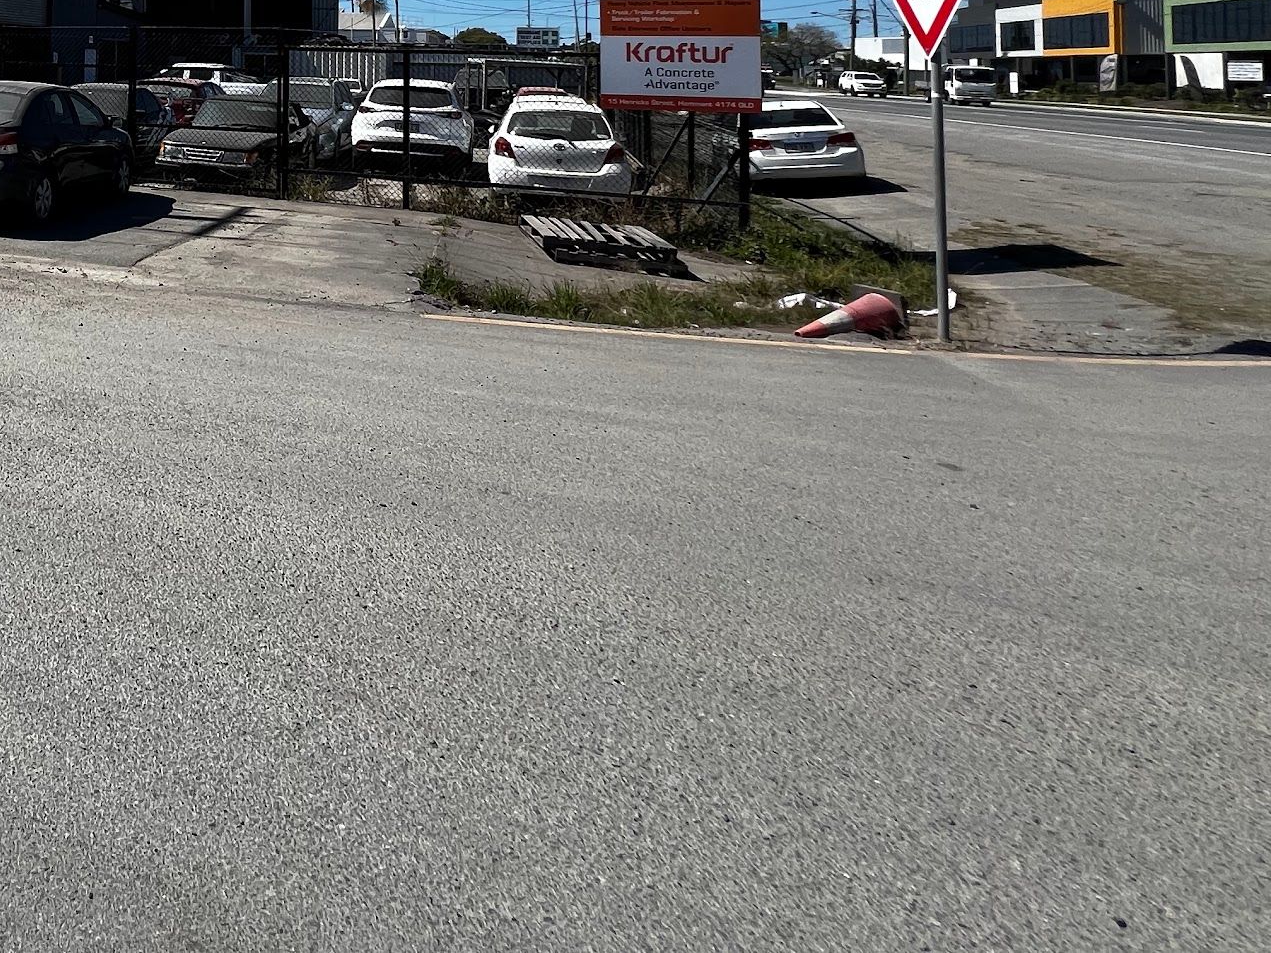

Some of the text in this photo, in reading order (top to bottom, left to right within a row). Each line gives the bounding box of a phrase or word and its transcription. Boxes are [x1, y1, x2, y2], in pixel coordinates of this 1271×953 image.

[625, 42, 733, 64] Kraftur
[644, 67, 715, 78] A Concrete
